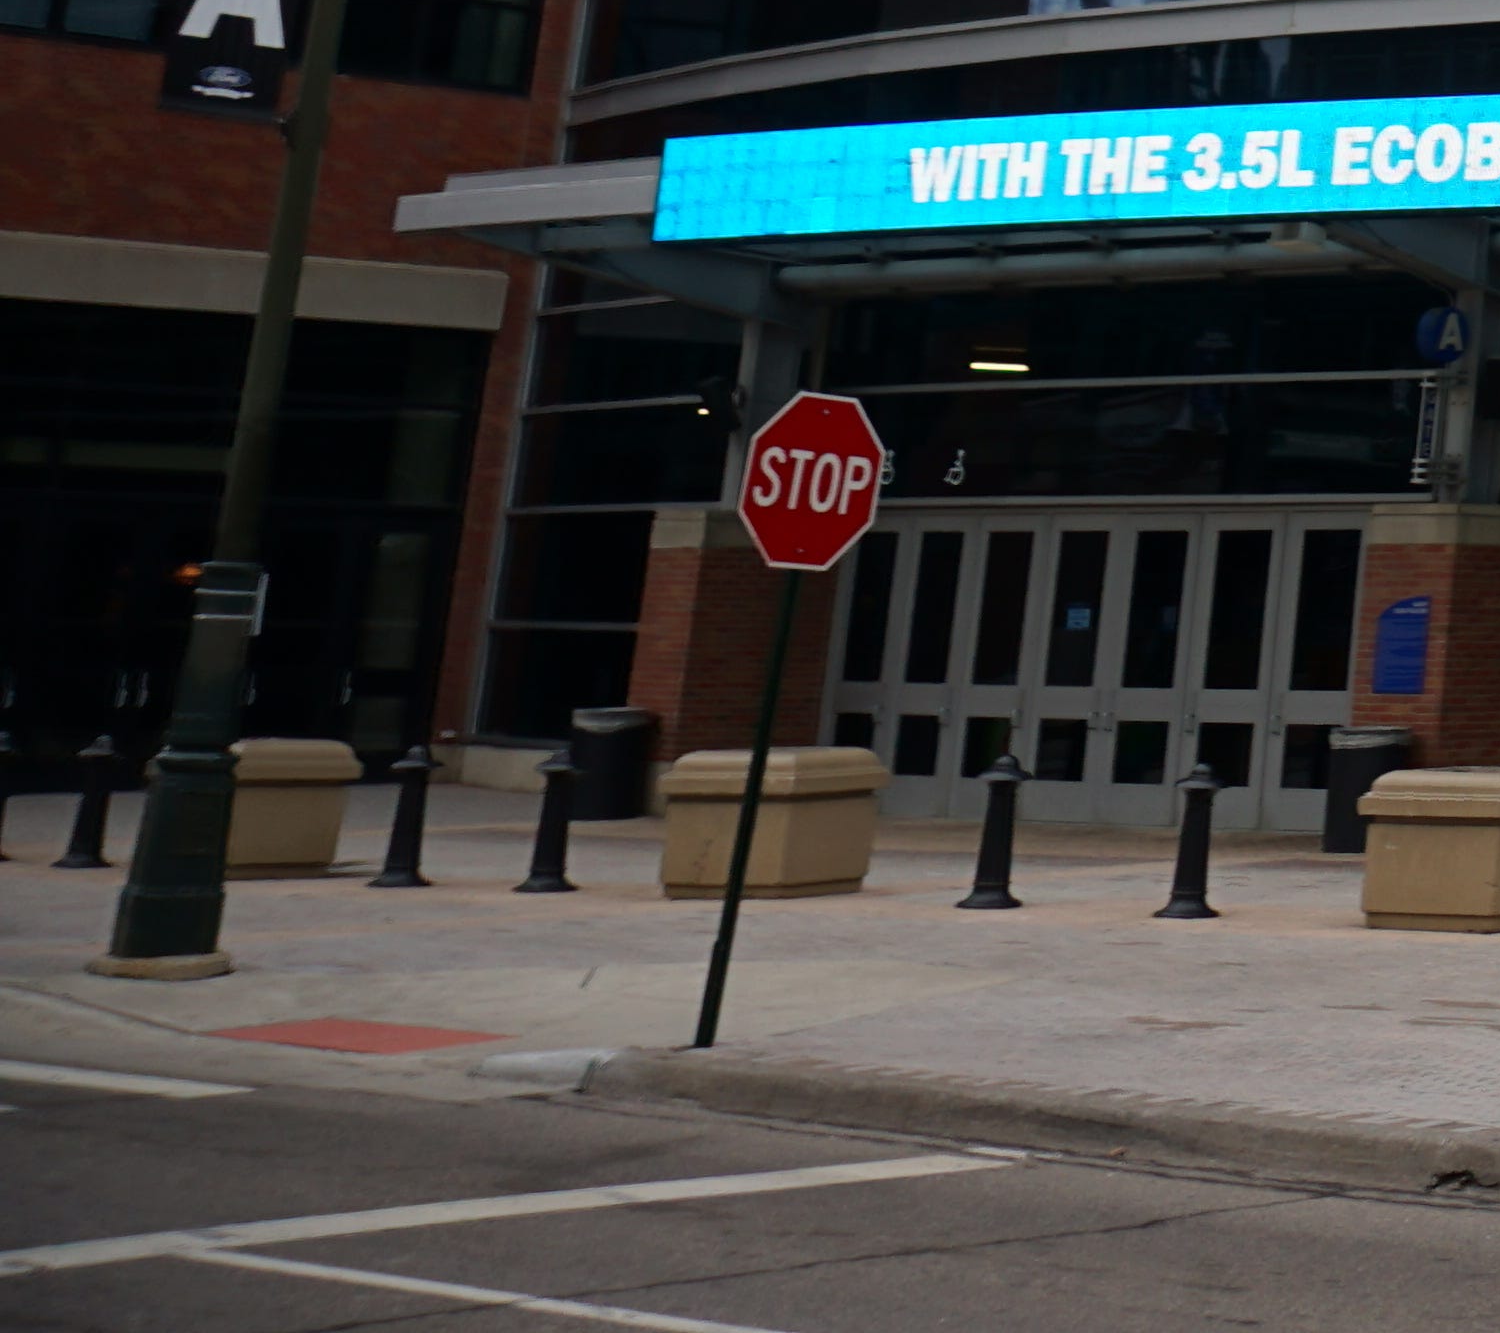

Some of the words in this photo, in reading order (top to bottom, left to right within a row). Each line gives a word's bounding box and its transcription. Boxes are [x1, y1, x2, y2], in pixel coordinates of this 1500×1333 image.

[910, 140, 1049, 203] WITH
[1060, 134, 1175, 197] THE
[1181, 129, 1316, 190] 3.5L
[1437, 311, 1465, 352] A
[752, 446, 873, 516] STOP
